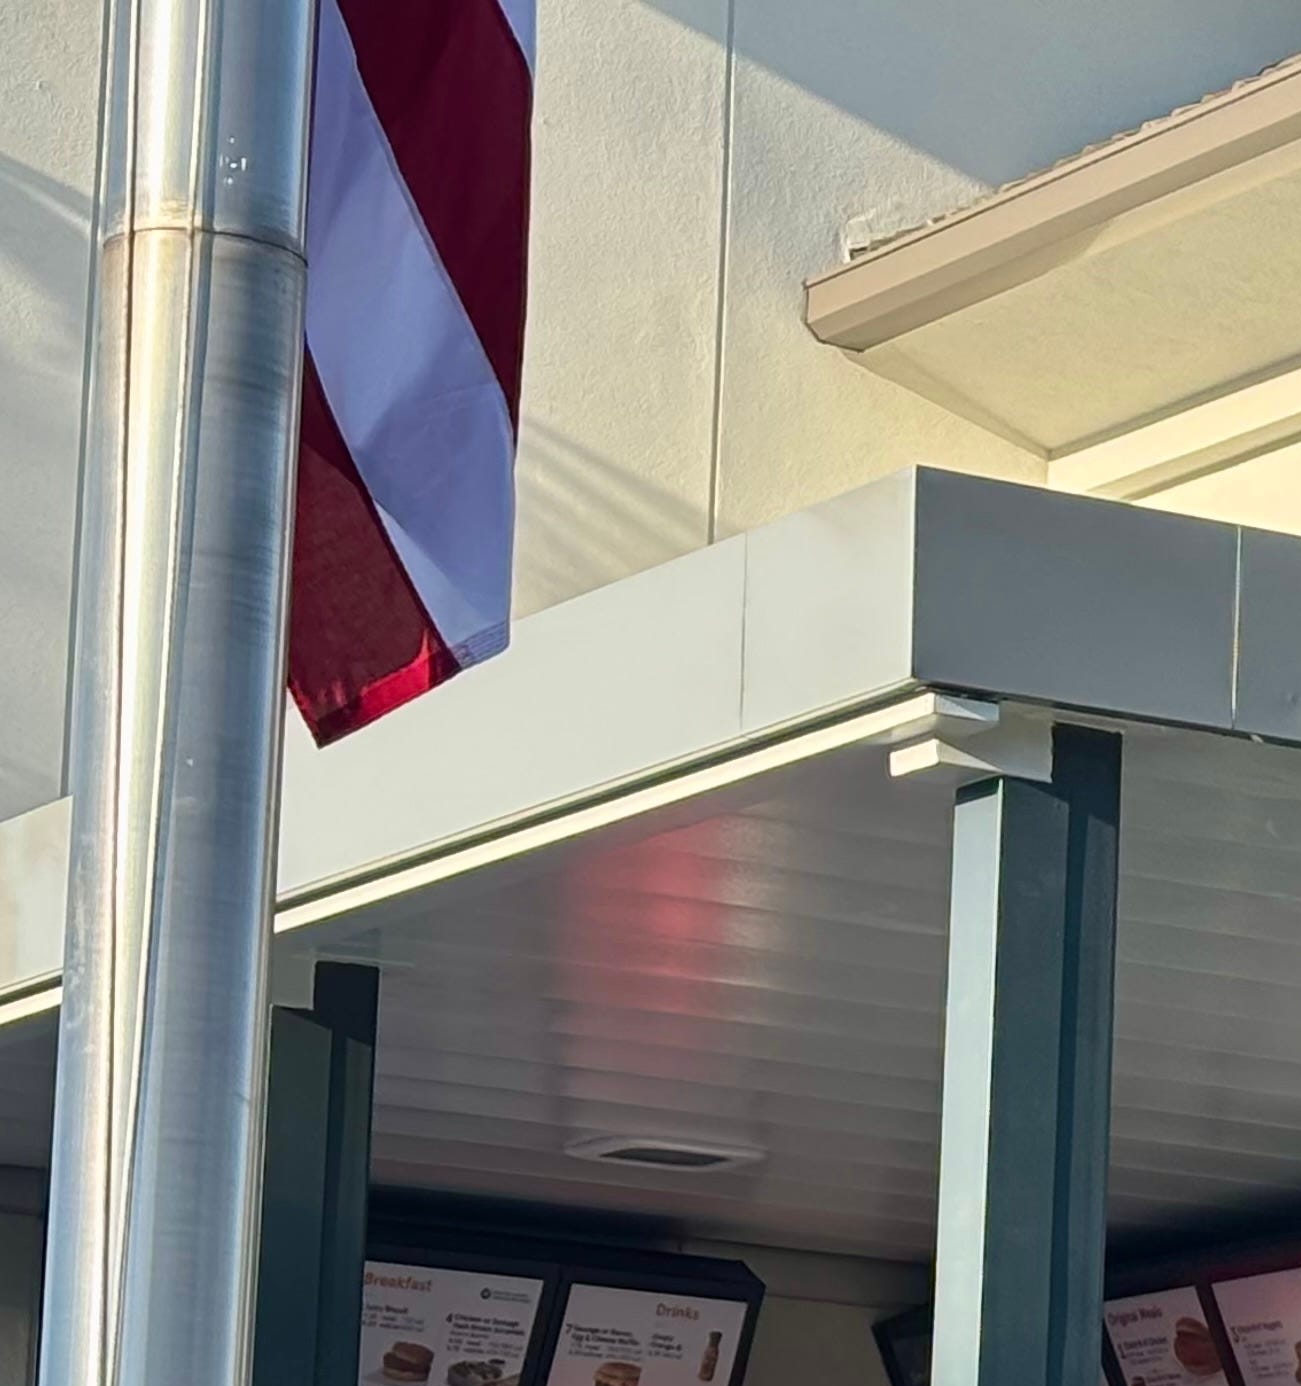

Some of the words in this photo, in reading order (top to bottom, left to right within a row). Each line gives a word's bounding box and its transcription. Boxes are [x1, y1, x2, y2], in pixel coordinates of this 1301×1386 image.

[365, 1273, 432, 1292] Breakfast
[656, 1302, 699, 1320] Drinks
[565, 1323, 572, 1334] 7
